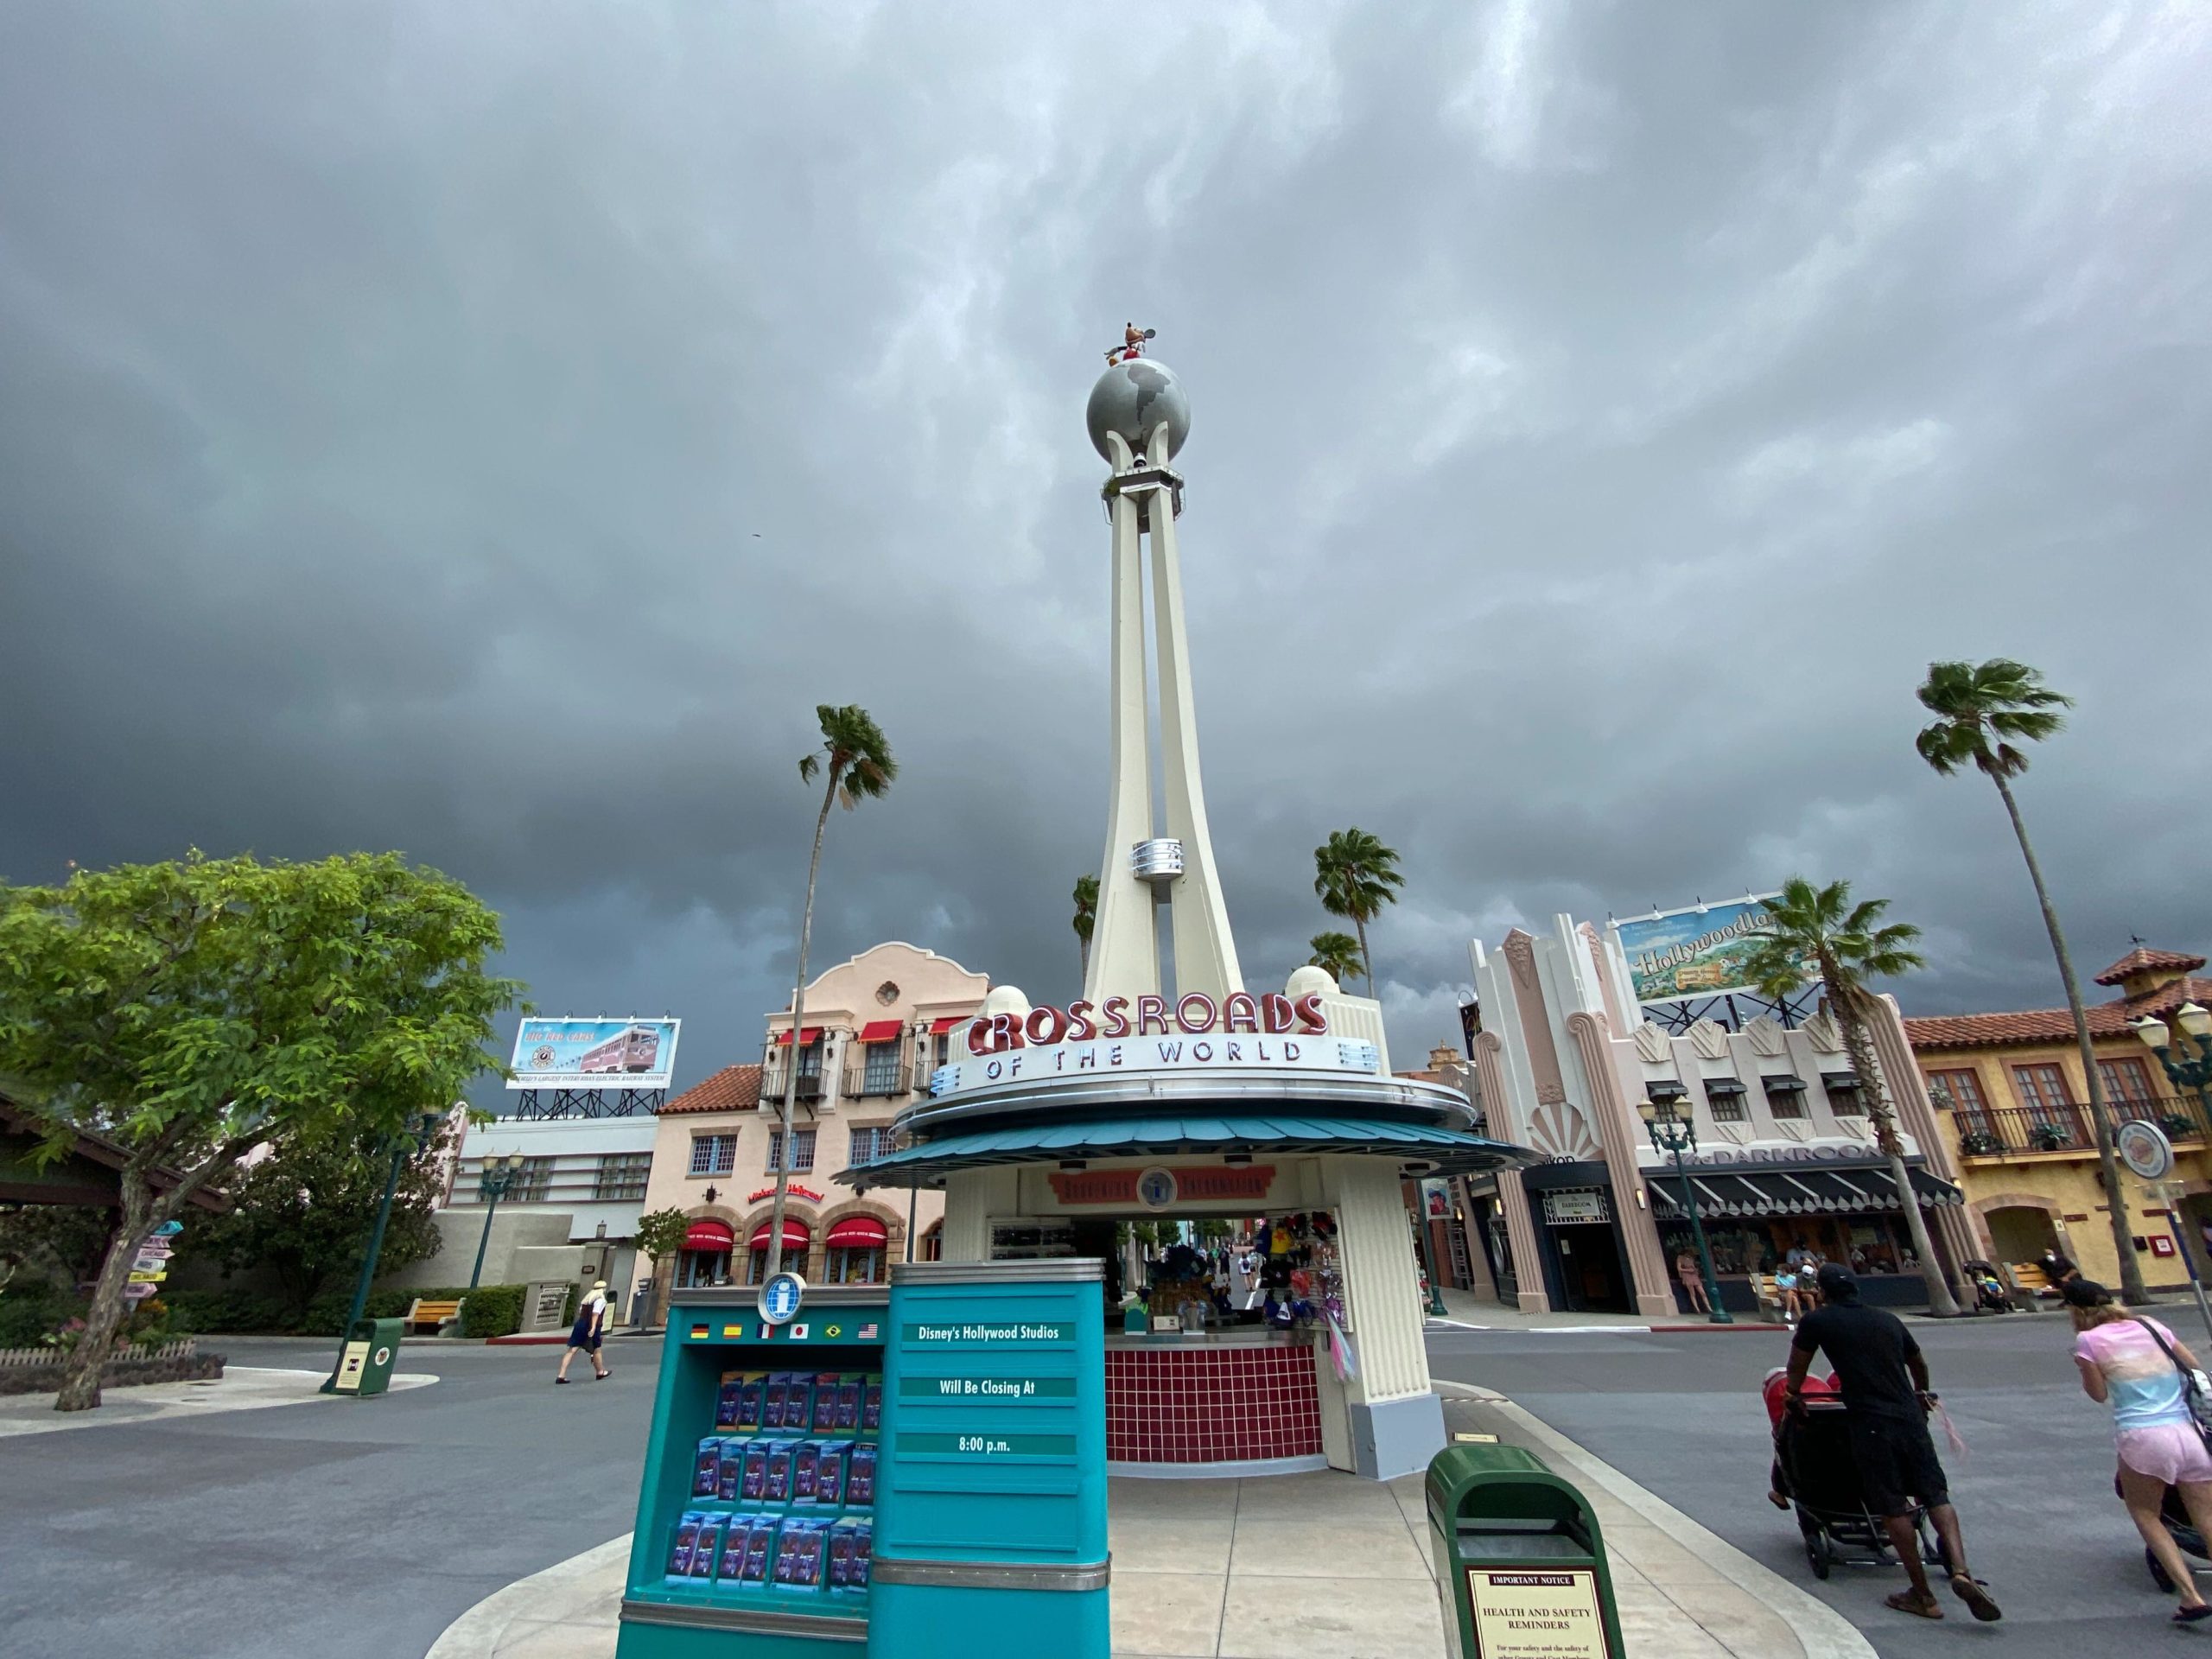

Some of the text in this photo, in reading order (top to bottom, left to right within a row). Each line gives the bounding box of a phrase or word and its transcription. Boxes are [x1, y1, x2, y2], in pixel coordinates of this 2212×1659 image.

[1634, 912, 1770, 978] Hollywoodla
[968, 992, 1328, 1056] CROSSROADS
[545, 1032, 565, 1041] RED
[987, 1041, 1301, 1080] OF THE WORLD
[918, 1325, 1059, 1342] Disney's Hollywood Studios
[940, 1380, 1035, 1398] Will Be Closing At
[959, 1437, 1010, 1454] 8:00 p.m.
[1493, 1576, 1571, 1585] IMPORTANT NOTICE
[1483, 1608, 1591, 1618] HEALTH AND SAFETY
[1508, 1621, 1570, 1630] REMINDERS
